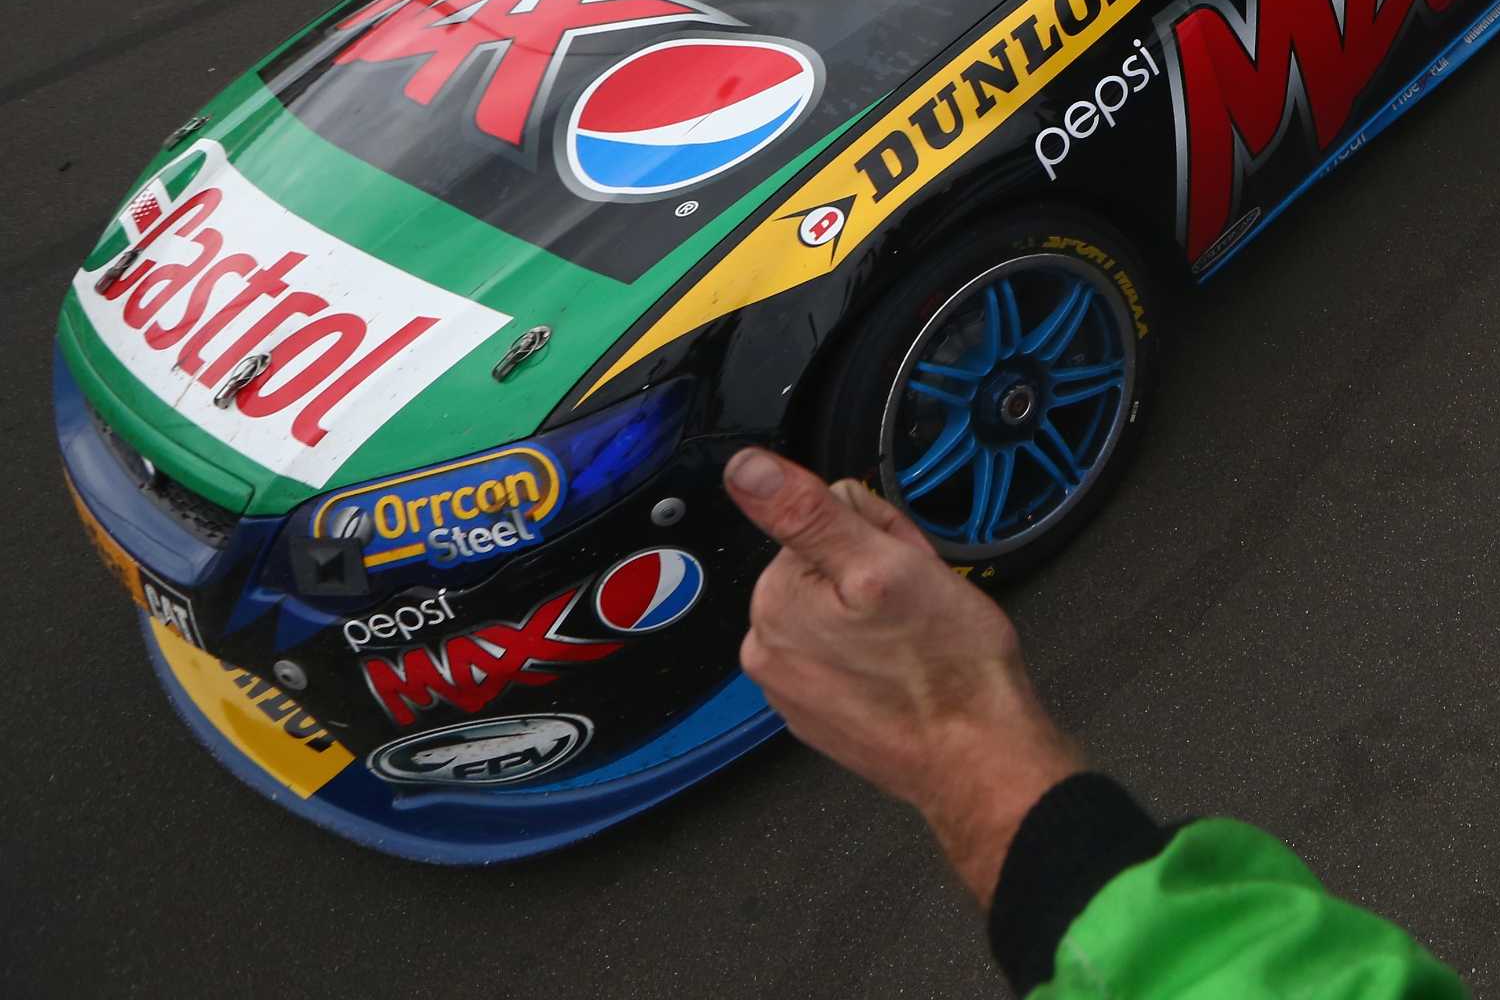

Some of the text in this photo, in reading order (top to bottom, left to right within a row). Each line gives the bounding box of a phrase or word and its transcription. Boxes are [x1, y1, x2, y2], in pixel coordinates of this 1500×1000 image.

[1035, 37, 1161, 182] pepsi
[101, 186, 442, 449] Castrol
[373, 469, 540, 541] Orrcon
[428, 507, 535, 561] Steel
[343, 588, 456, 652] pepsi
[362, 586, 626, 727] MAX
